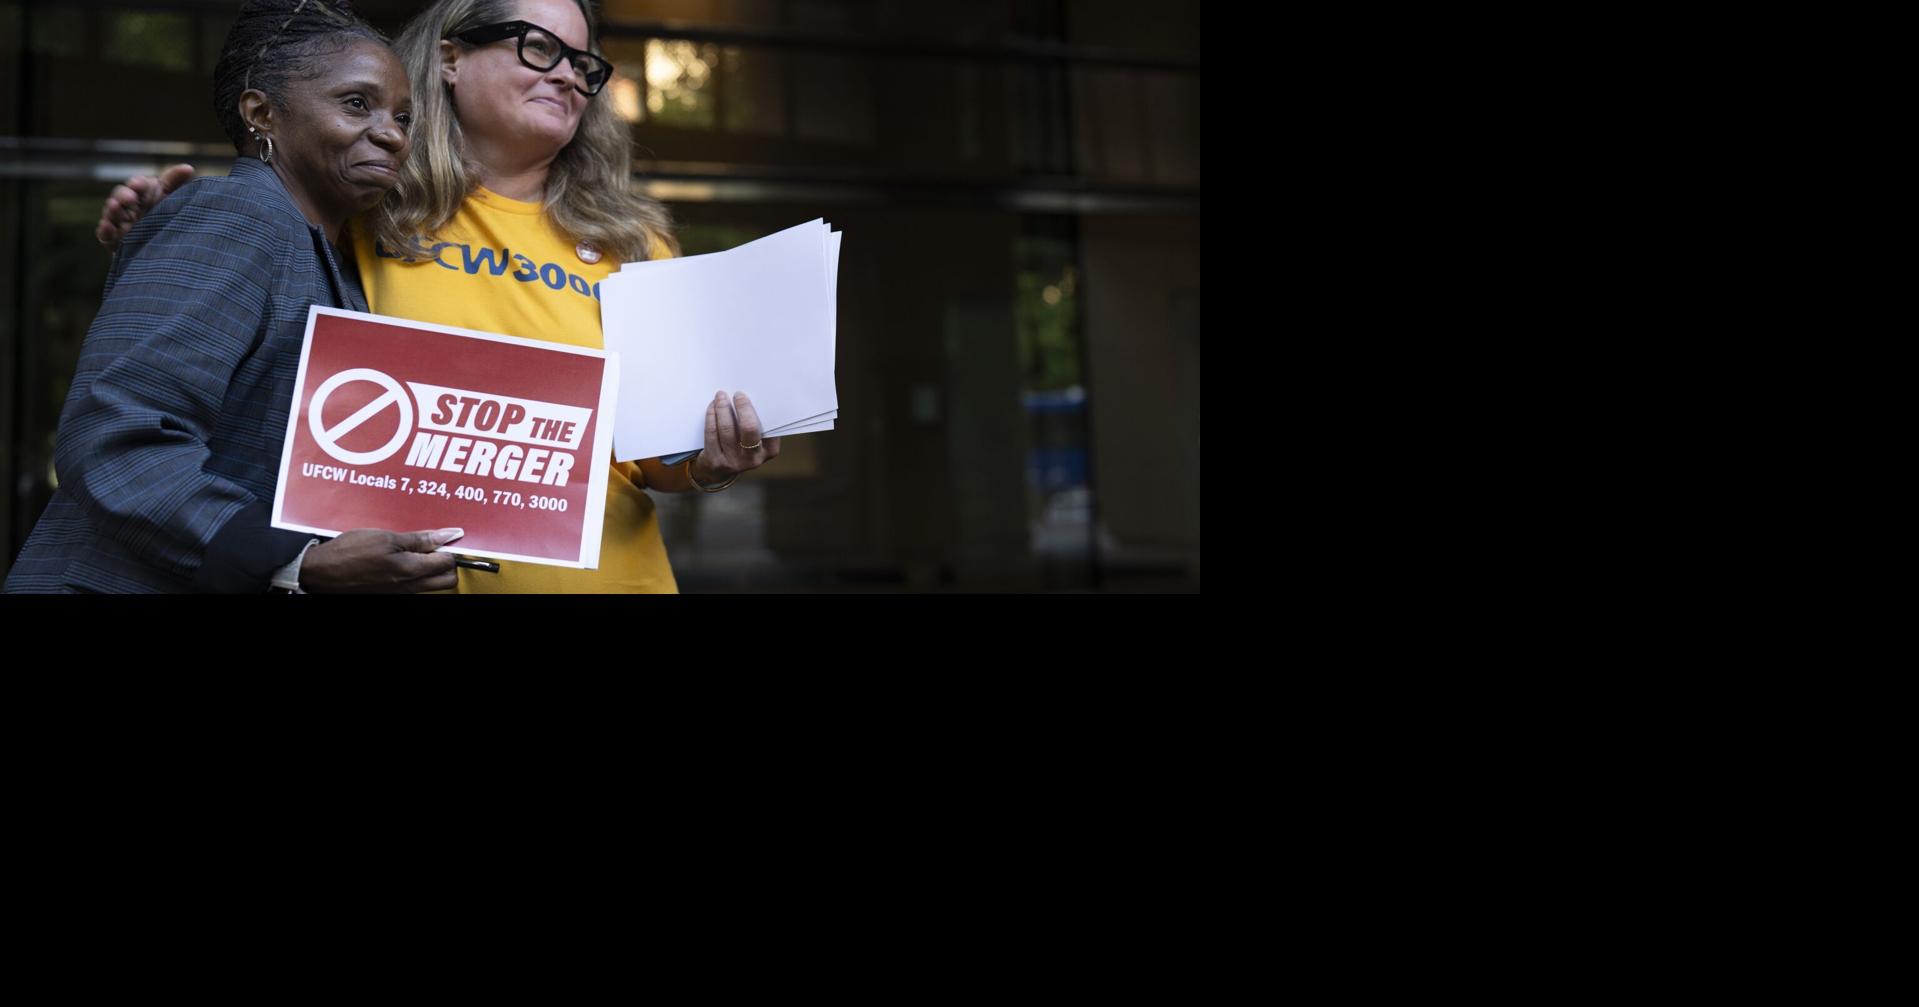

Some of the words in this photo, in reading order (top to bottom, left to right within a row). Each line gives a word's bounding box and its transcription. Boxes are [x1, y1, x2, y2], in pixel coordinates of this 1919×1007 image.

[431, 394, 526, 434] STOP
[529, 417, 576, 443] THE
[405, 432, 576, 487] MERGER
[302, 463, 348, 482] UFCW
[350, 471, 397, 490] Locals
[401, 478, 414, 494] 7,
[417, 481, 450, 500] 324,
[455, 487, 488, 505] 400,
[493, 491, 525, 509] 770,
[529, 495, 568, 512] 3000
